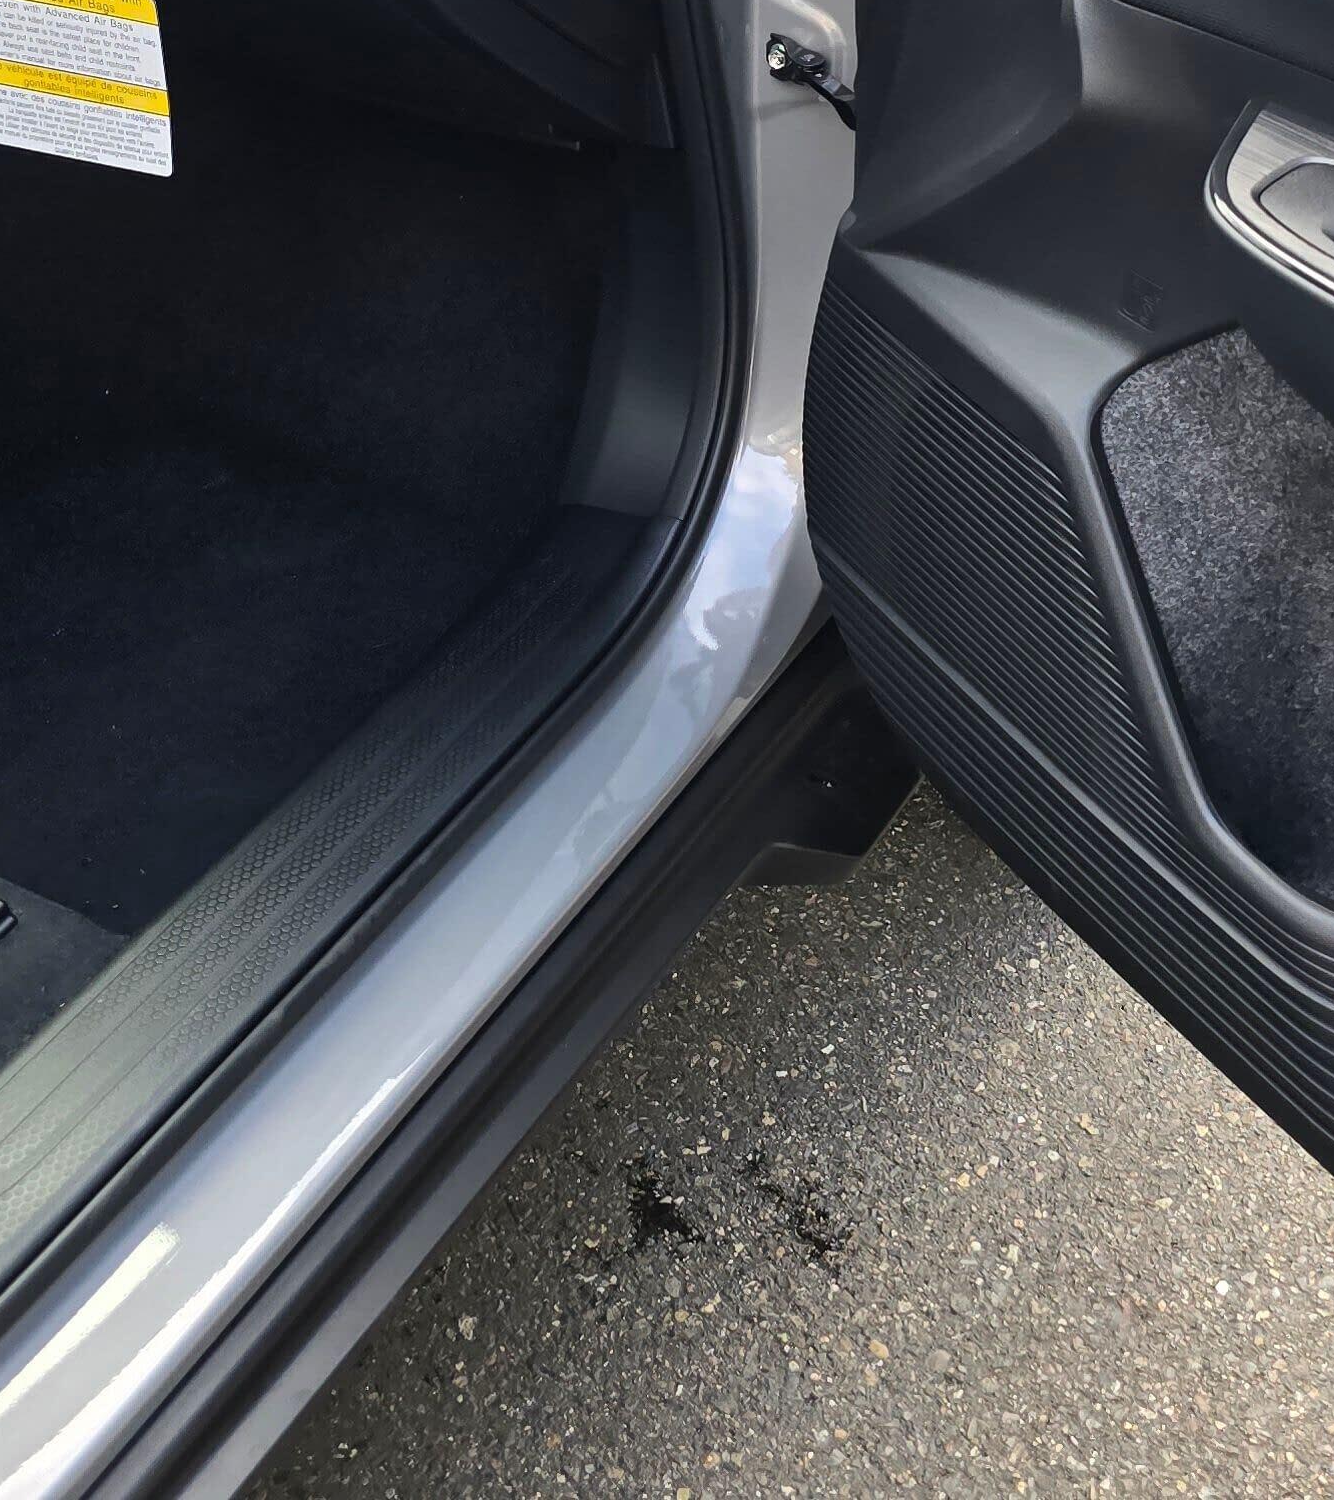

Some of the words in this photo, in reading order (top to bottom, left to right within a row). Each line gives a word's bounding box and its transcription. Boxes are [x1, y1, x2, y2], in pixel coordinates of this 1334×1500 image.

[23, 4, 41, 13] with
[46, 7, 90, 23] Advanced
[94, 16, 107, 25] Air
[110, 19, 134, 32] Bags
[88, 1, 116, 15] Bags
